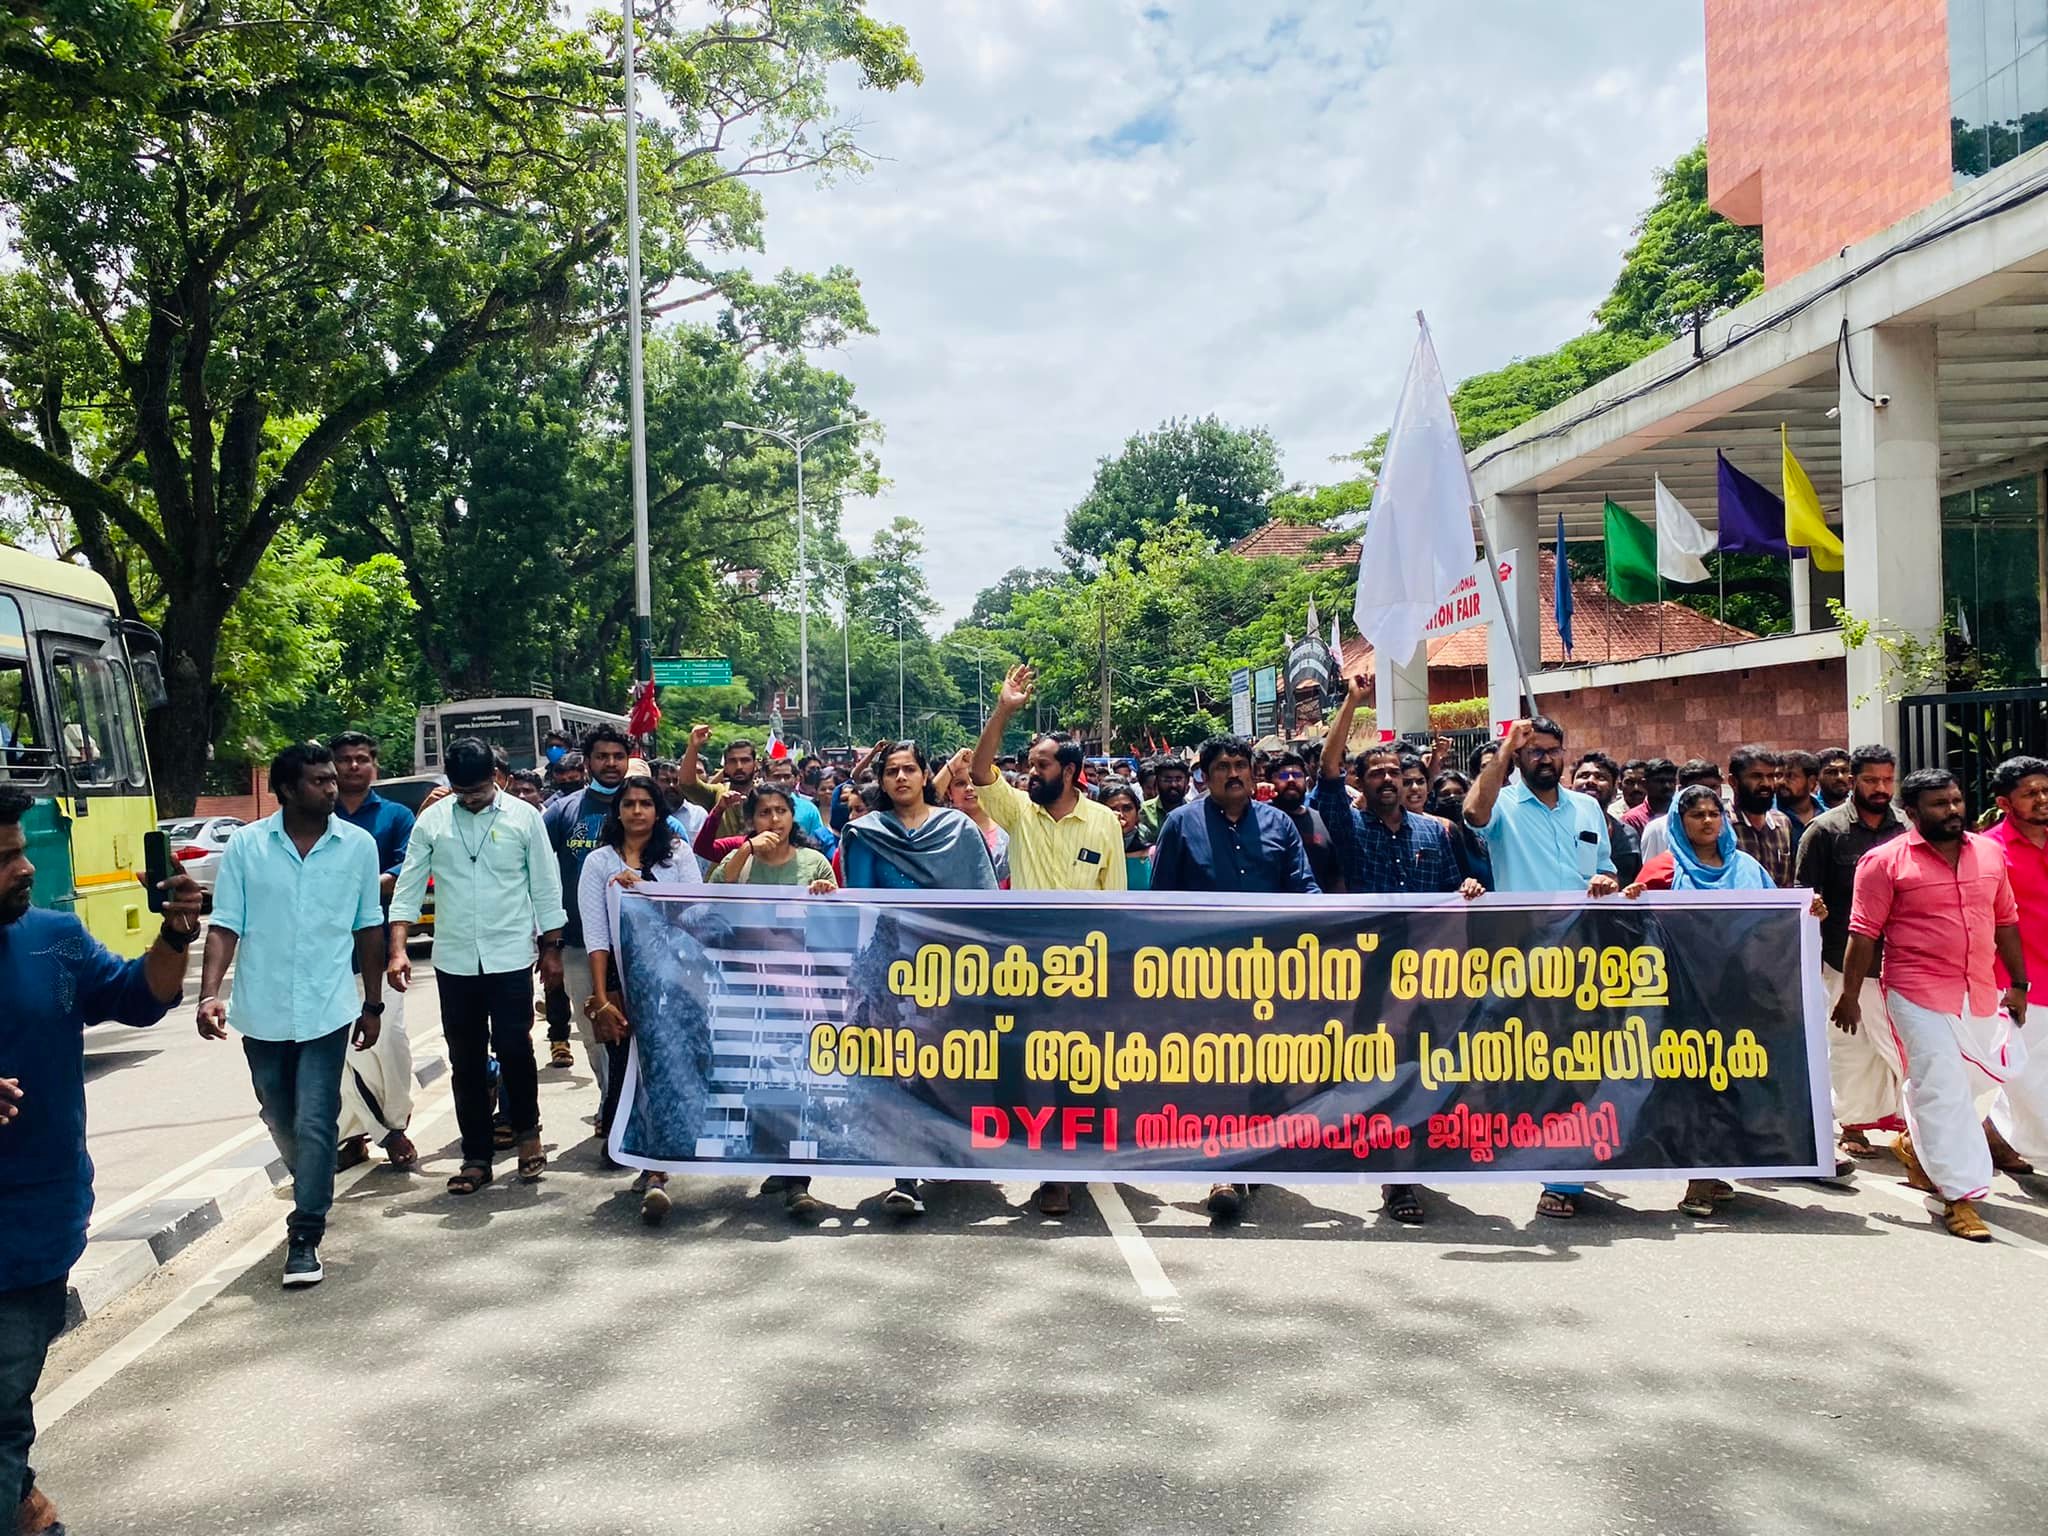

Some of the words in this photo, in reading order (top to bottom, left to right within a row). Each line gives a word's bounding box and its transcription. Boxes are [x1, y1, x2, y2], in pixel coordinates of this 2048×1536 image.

[1457, 592, 1481, 622] FAIR
[888, 930, 1108, 1008] എകെജി
[1390, 945, 1670, 1012] നേരേയുള്ള
[809, 1015, 1014, 1080] ബോംബ്
[1024, 1019, 1396, 1095] ആക്രമണത്തിൽ
[1419, 1015, 1769, 1092] പ്രതിഷേധിക്കുക
[970, 1105, 1118, 1151] DYFI
[1135, 1103, 1411, 1159] തിരുവനന്തപുരം
